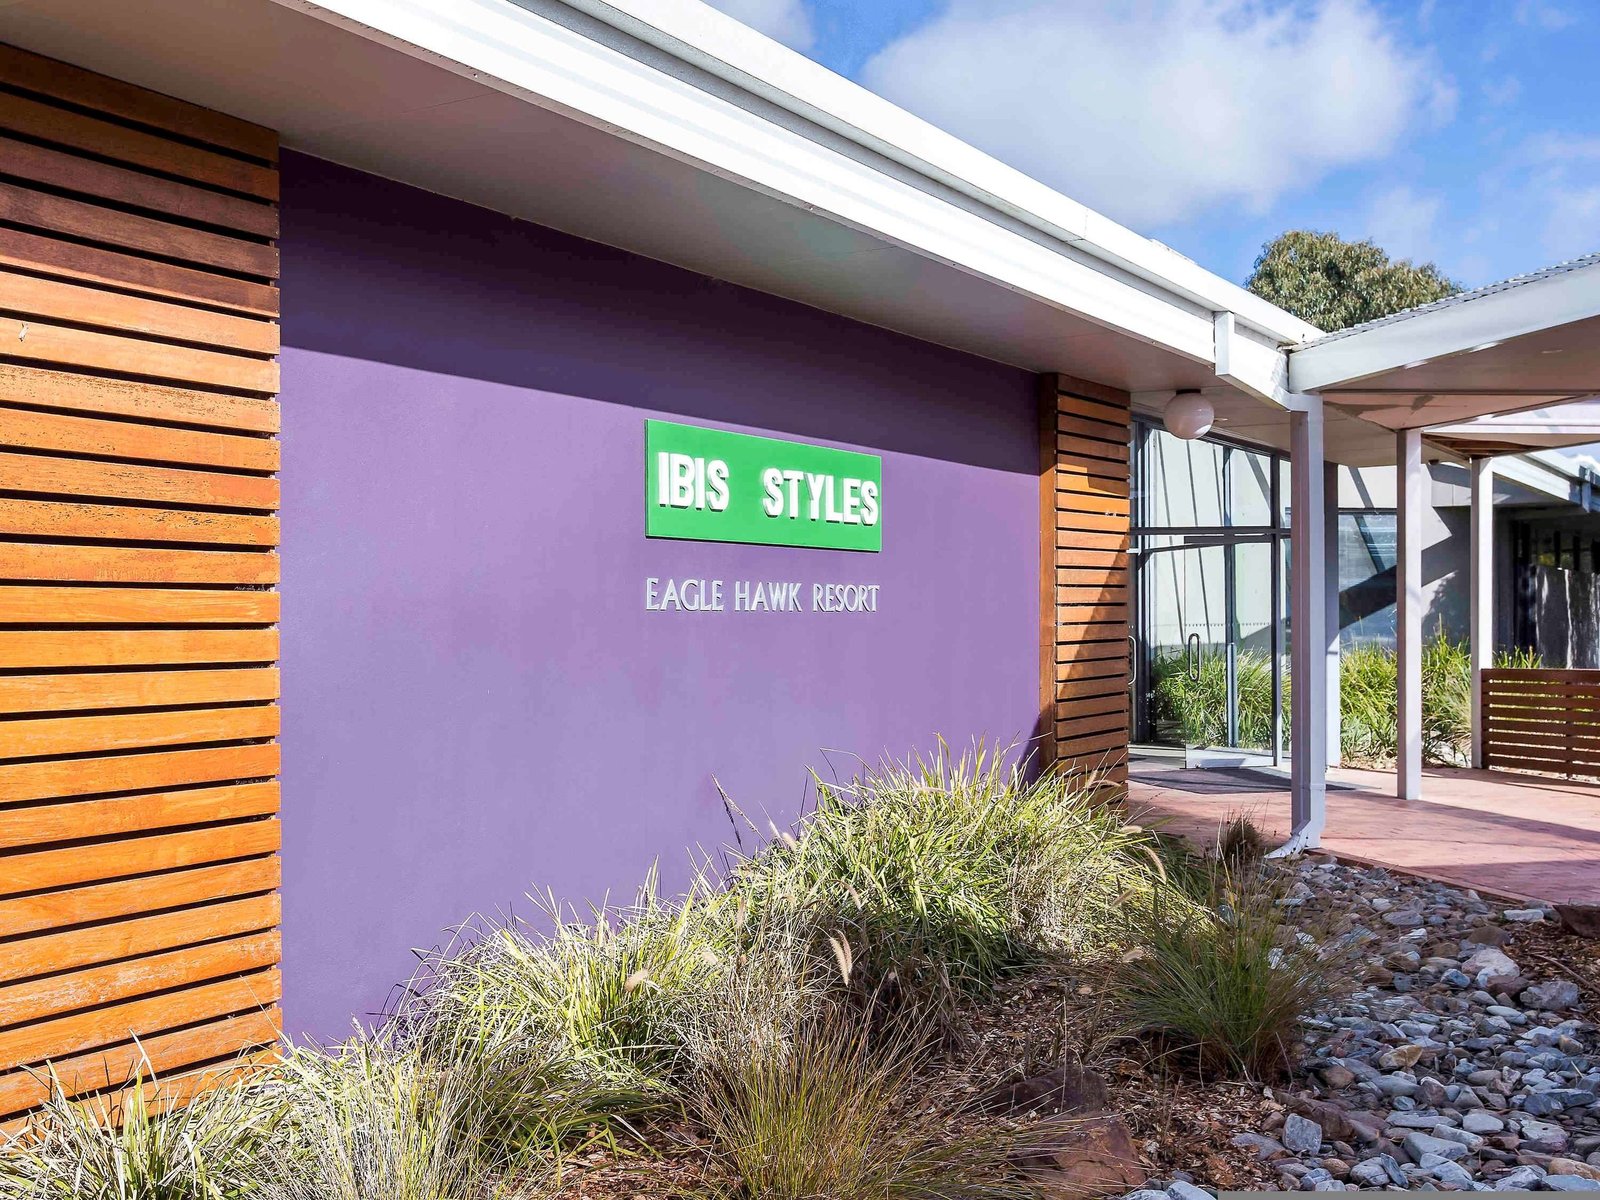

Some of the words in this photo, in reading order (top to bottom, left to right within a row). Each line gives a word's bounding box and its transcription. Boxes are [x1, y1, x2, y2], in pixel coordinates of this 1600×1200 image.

[658, 452, 730, 512] IBIS
[762, 467, 879, 526] STYLES
[645, 577, 724, 612] EAGLE
[734, 581, 803, 612] HAWK
[812, 583, 881, 613] RESORT
